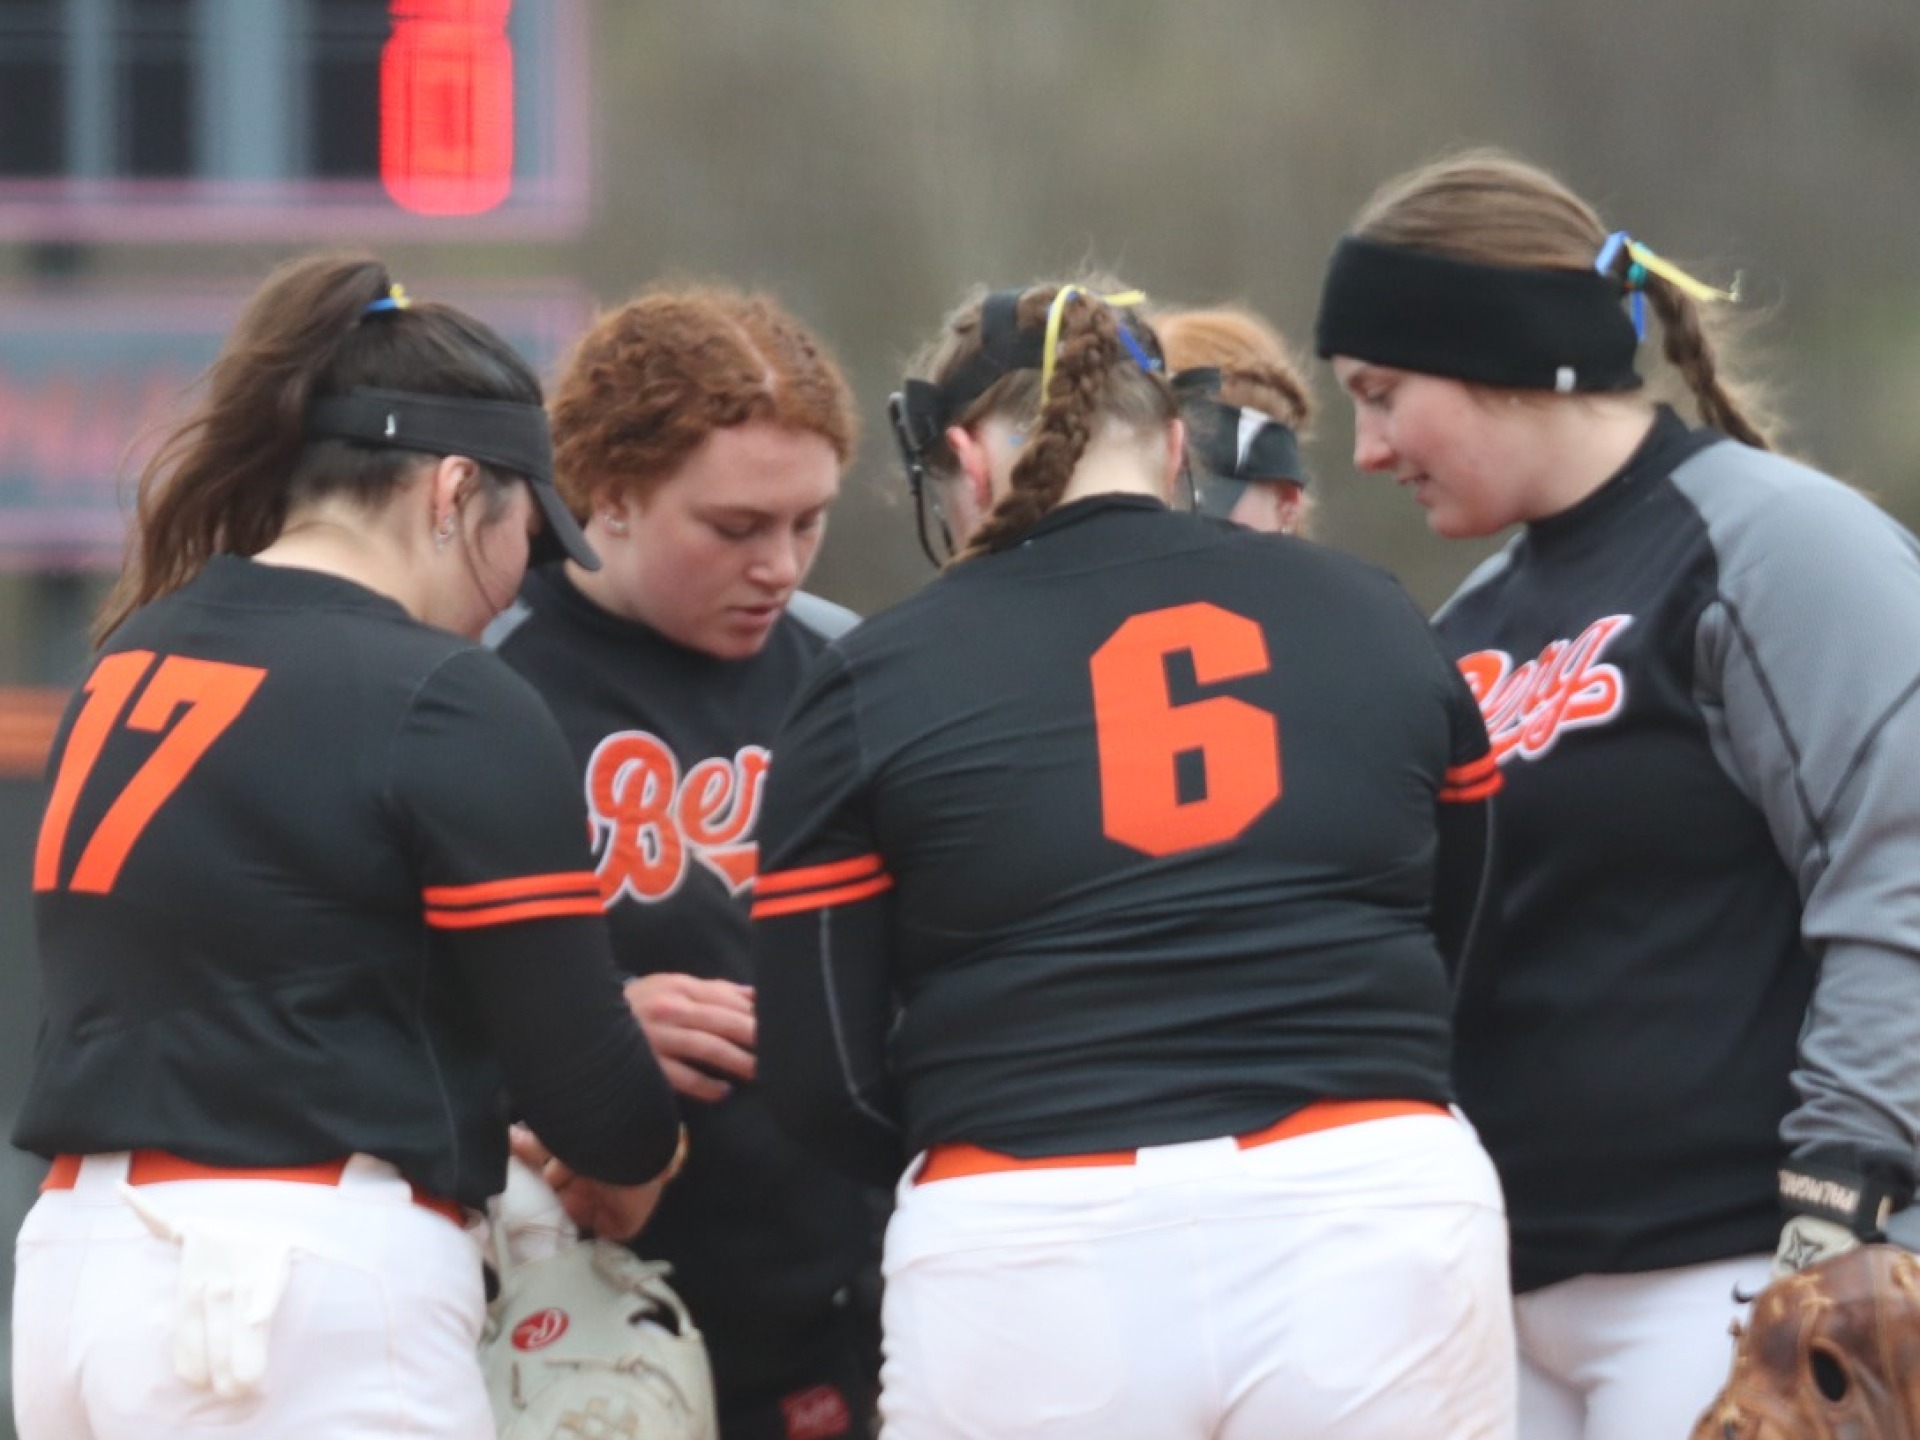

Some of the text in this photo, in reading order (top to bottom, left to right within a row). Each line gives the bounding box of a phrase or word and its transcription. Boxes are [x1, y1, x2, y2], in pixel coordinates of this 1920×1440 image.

[33, 649, 268, 894] 17
[585, 729, 771, 906] Ber
[1089, 601, 1282, 858] 6
